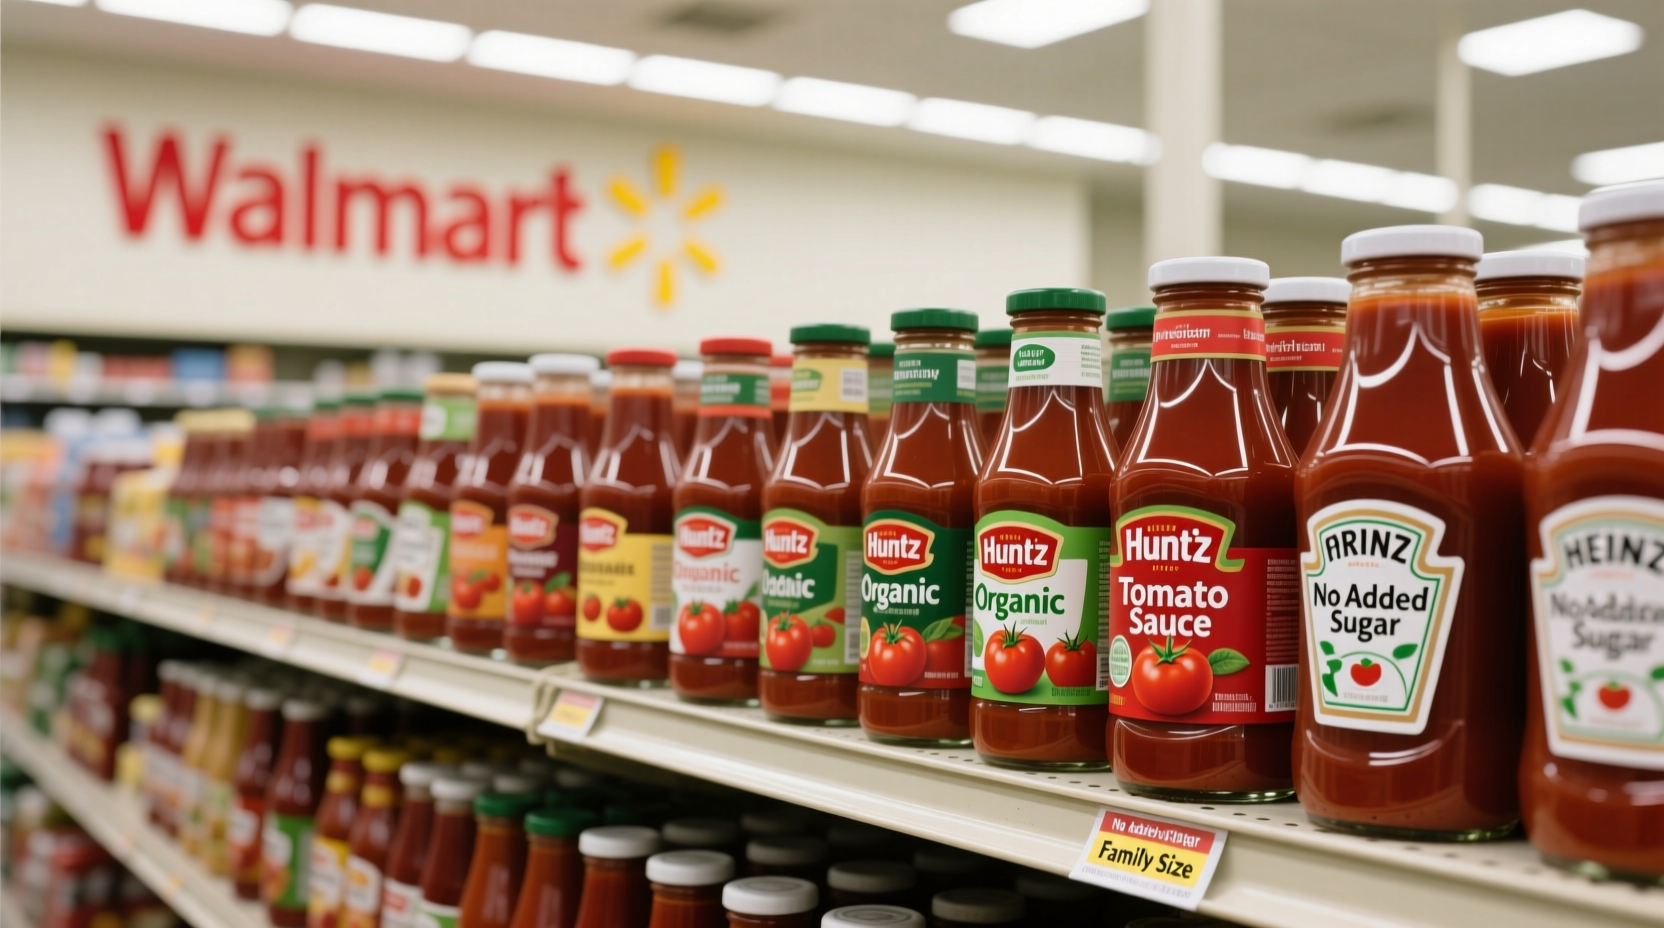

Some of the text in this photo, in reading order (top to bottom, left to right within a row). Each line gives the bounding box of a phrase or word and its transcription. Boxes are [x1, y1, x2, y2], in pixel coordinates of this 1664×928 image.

[101, 123, 584, 271] Walmart
[1324, 528, 1412, 565] ARINZ
[1565, 534, 1664, 575] HEINZ
[861, 572, 941, 611] Organic
[975, 582, 1066, 621] Organic
[1118, 576, 1230, 610] Tomato
[1313, 582, 1429, 612] No Added
[1129, 606, 1213, 638] Sauce
[1330, 609, 1402, 643] Sugar
[1098, 840, 1194, 880] Family Size
